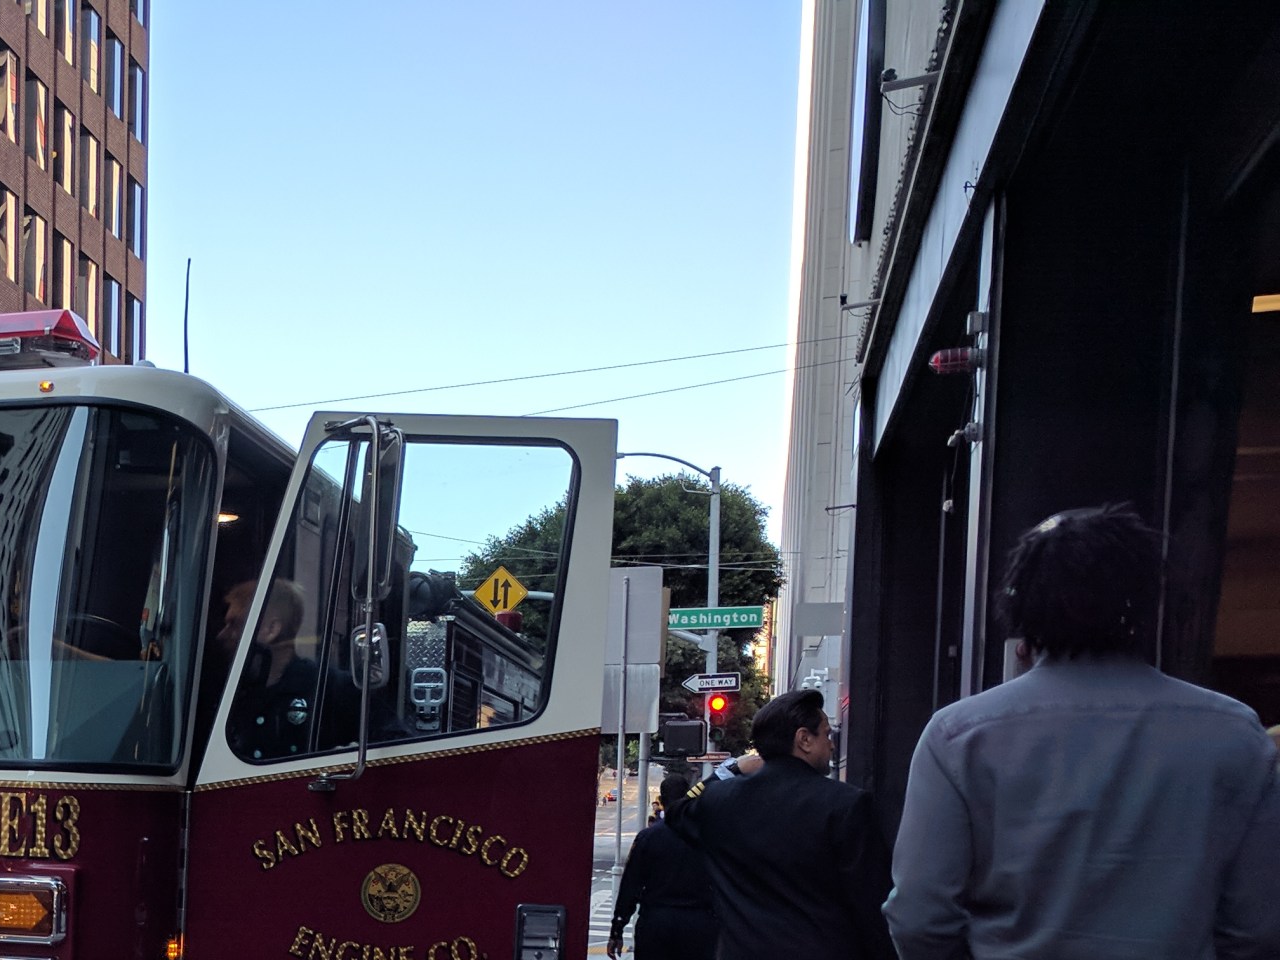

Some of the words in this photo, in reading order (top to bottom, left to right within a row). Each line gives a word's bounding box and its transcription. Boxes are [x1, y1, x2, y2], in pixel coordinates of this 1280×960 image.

[669, 613, 757, 625] Washington
[252, 818, 322, 870] SAN
[332, 808, 529, 878] FRANCISCO
